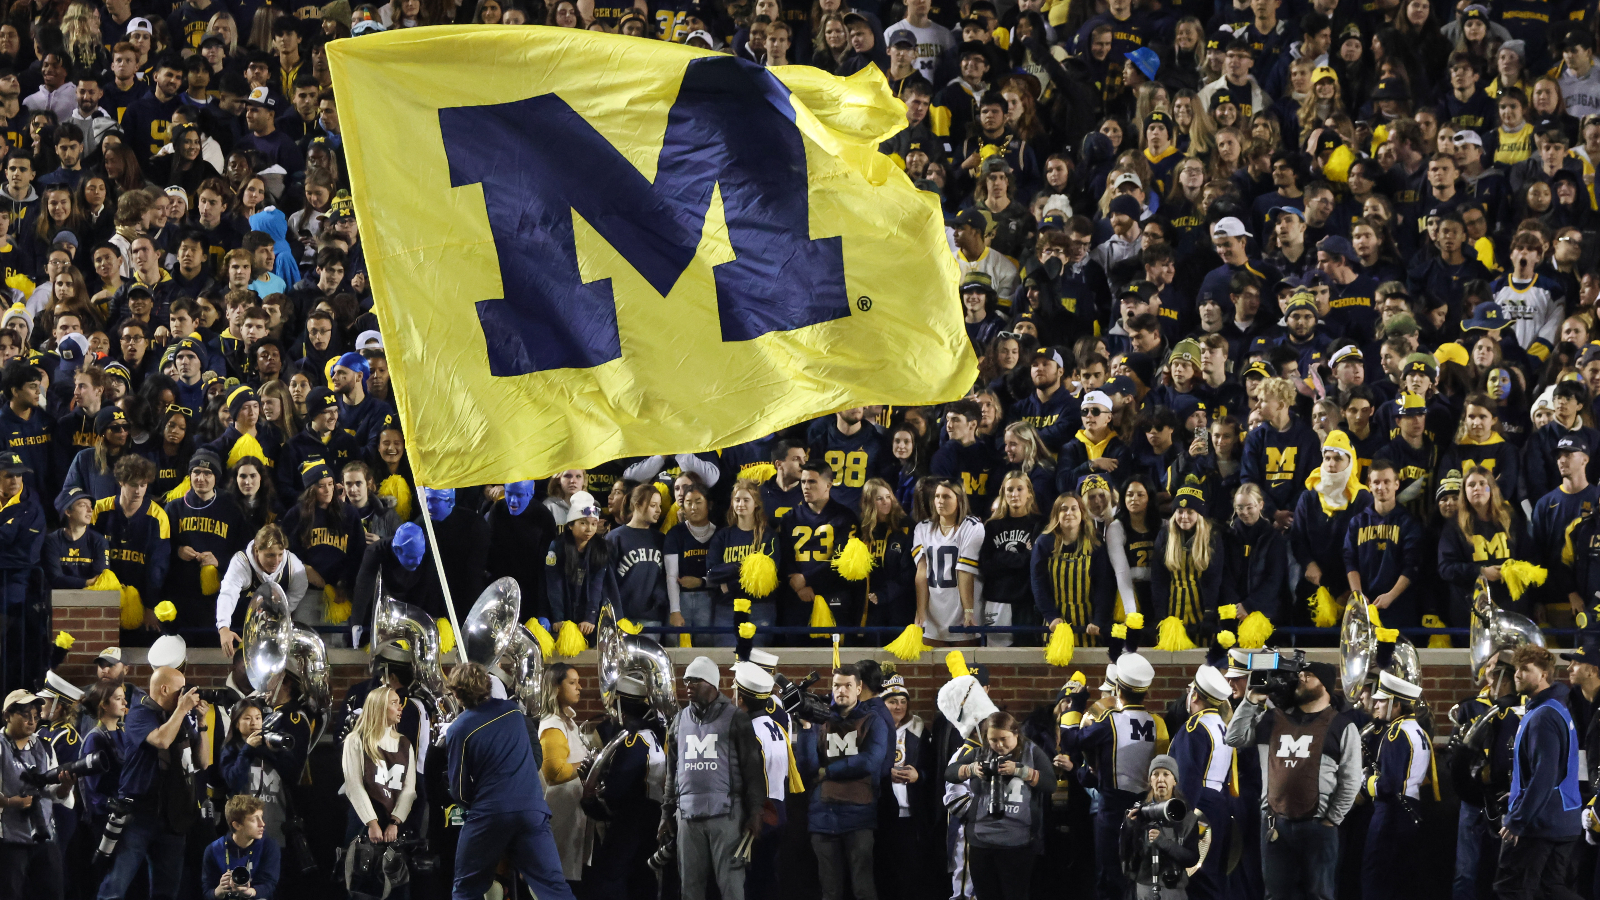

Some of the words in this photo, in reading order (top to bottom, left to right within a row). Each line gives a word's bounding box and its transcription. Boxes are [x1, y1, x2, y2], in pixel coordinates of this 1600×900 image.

[184, 21, 209, 35] MICHIG
[1113, 31, 1142, 46] HIGAN
[1207, 39, 1220, 49] M
[921, 60, 934, 69] M
[1219, 95, 1231, 103] M
[1152, 113, 1163, 121] M
[340, 208, 351, 216] M
[439, 56, 850, 377] M
[1486, 309, 1497, 319] M
[182, 340, 193, 348] M
[30, 358, 40, 366] M
[1312, 352, 1321, 360] M
[1412, 362, 1425, 371] M
[323, 394, 337, 405] M
[113, 411, 126, 420] M
[12, 454, 23, 464] M
[338, 450, 348, 458] M
[1265, 447, 1298, 473] M
[824, 450, 869, 488] 88
[961, 471, 989, 496] M
[178, 516, 230, 540] MICHIGAN
[309, 527, 349, 554] CHIGAN
[1357, 524, 1400, 547] MICHIAN
[791, 525, 835, 562] 23
[1377, 542, 1387, 551] M
[1472, 532, 1511, 562] M
[68, 548, 80, 558] M
[109, 548, 147, 565] CHIGA
[683, 549, 710, 559] MICHI
[617, 548, 664, 577] MICHIG
[926, 544, 958, 591] 10
[1424, 617, 1433, 625] M
[970, 667, 980, 675] M
[764, 720, 785, 742] M
[1130, 718, 1156, 742] M
[684, 733, 720, 759] M
[827, 730, 860, 758] M
[1279, 734, 1313, 759] M
[685, 762, 718, 771] PHOTO
[1285, 759, 1298, 768] TV
[250, 766, 285, 794] M
[374, 760, 406, 791] M
[382, 788, 394, 800] TV
